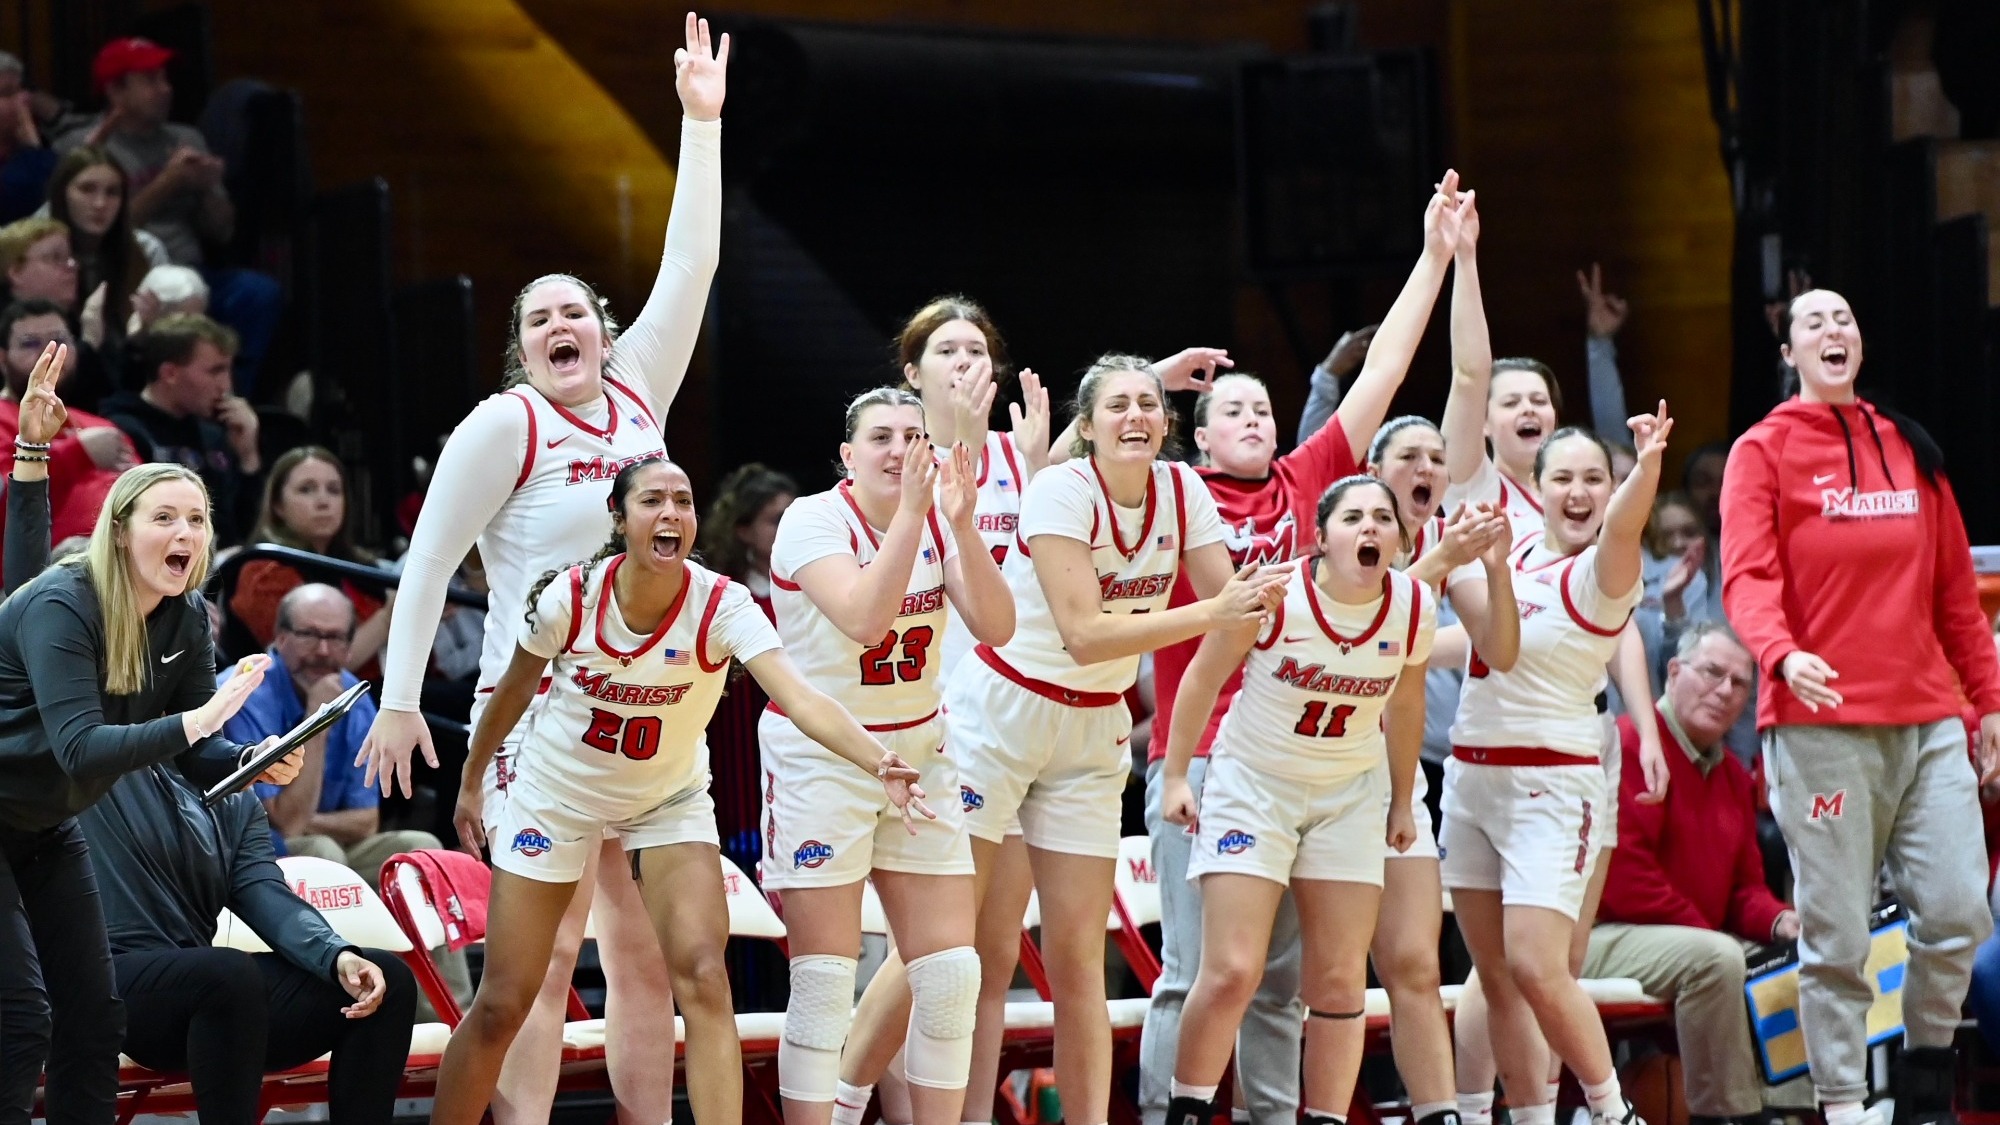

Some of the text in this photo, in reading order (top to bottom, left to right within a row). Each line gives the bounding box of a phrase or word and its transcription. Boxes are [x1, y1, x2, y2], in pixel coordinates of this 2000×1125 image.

[1822, 487, 1919, 516] MARIST
[974, 512, 1019, 533] RIS
[897, 584, 945, 617] RIST
[859, 625, 933, 685] 23
[571, 665, 693, 706] MARIST
[1272, 656, 1397, 697] MARIST
[581, 707, 662, 760] 20
[1294, 700, 1357, 737] 11
[1808, 789, 1846, 822] M
[511, 833, 552, 852] MAAC
[794, 845, 834, 870] MAAC
[1217, 834, 1256, 855] MAAC
